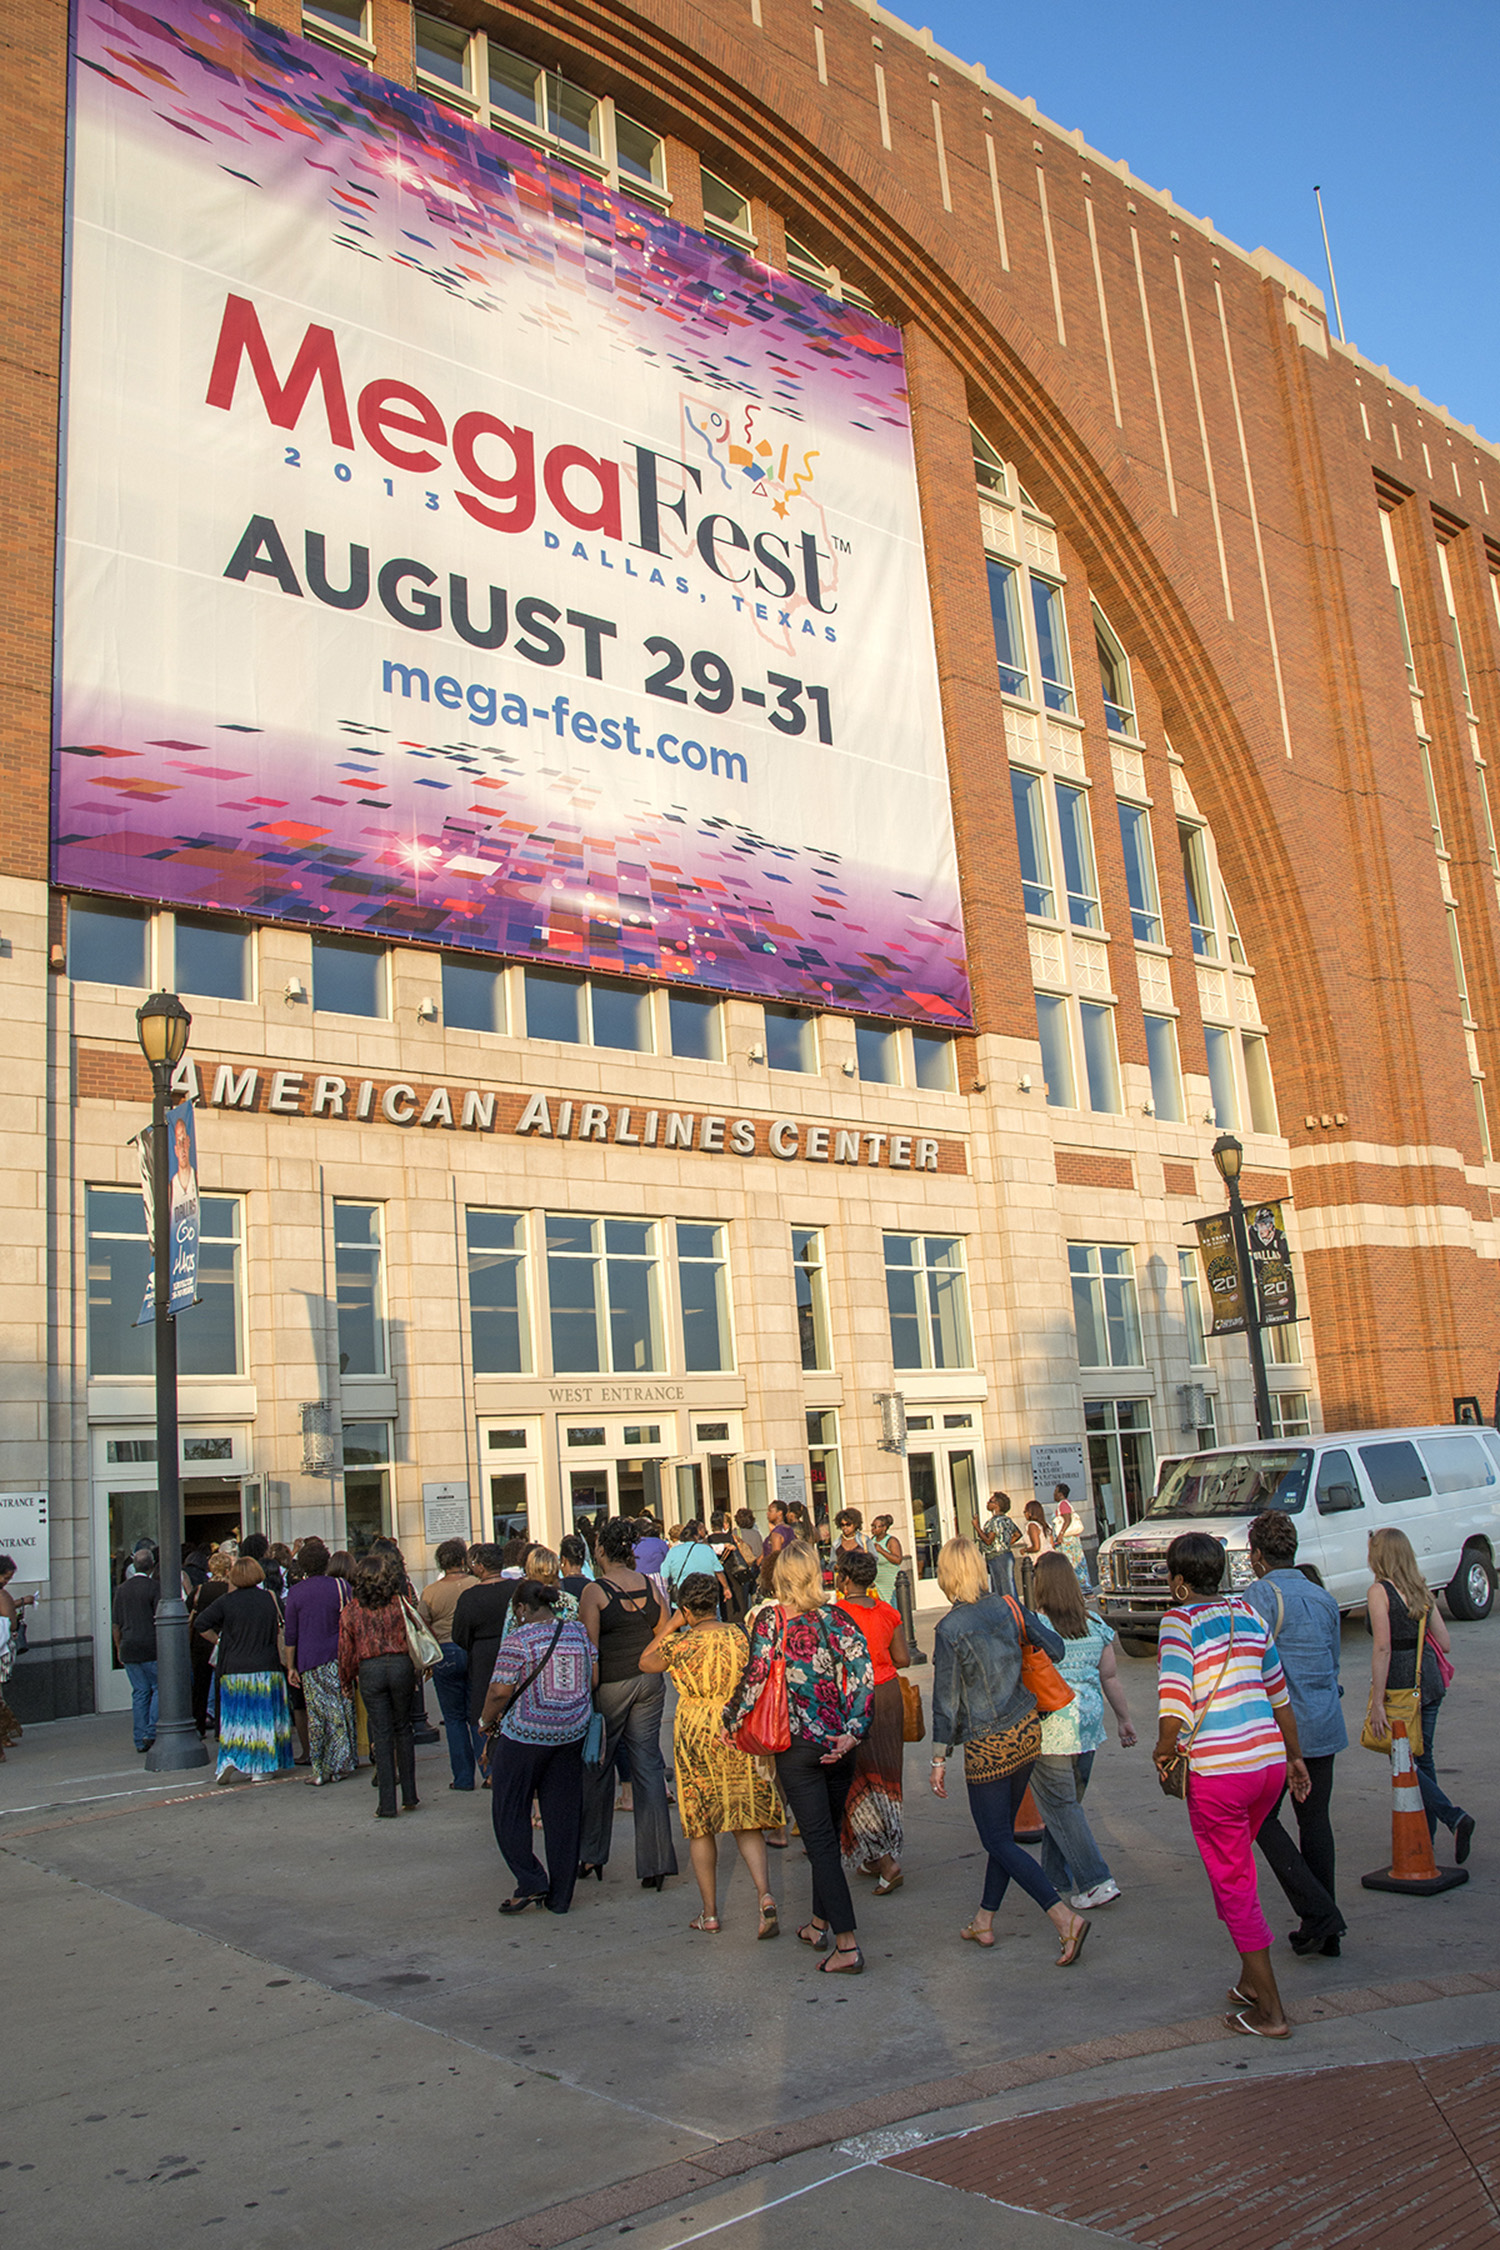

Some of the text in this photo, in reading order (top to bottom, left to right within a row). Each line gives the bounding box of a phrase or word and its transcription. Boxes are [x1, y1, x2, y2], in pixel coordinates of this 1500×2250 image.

[205, 292, 838, 616] MegaFest
[285, 448, 441, 511] 2013
[223, 514, 834, 746] AUGUST 29-31
[544, 531, 838, 643] DALLAS, TEXAS
[381, 660, 749, 784] mega-fest.com
[171, 1056, 939, 1172] AMERICAN AIRLINES CENTER
[1212, 1275, 1237, 1293] 20
[1263, 1280, 1288, 1296] 20
[548, 1386, 685, 1402] WEST ENTRANCE
